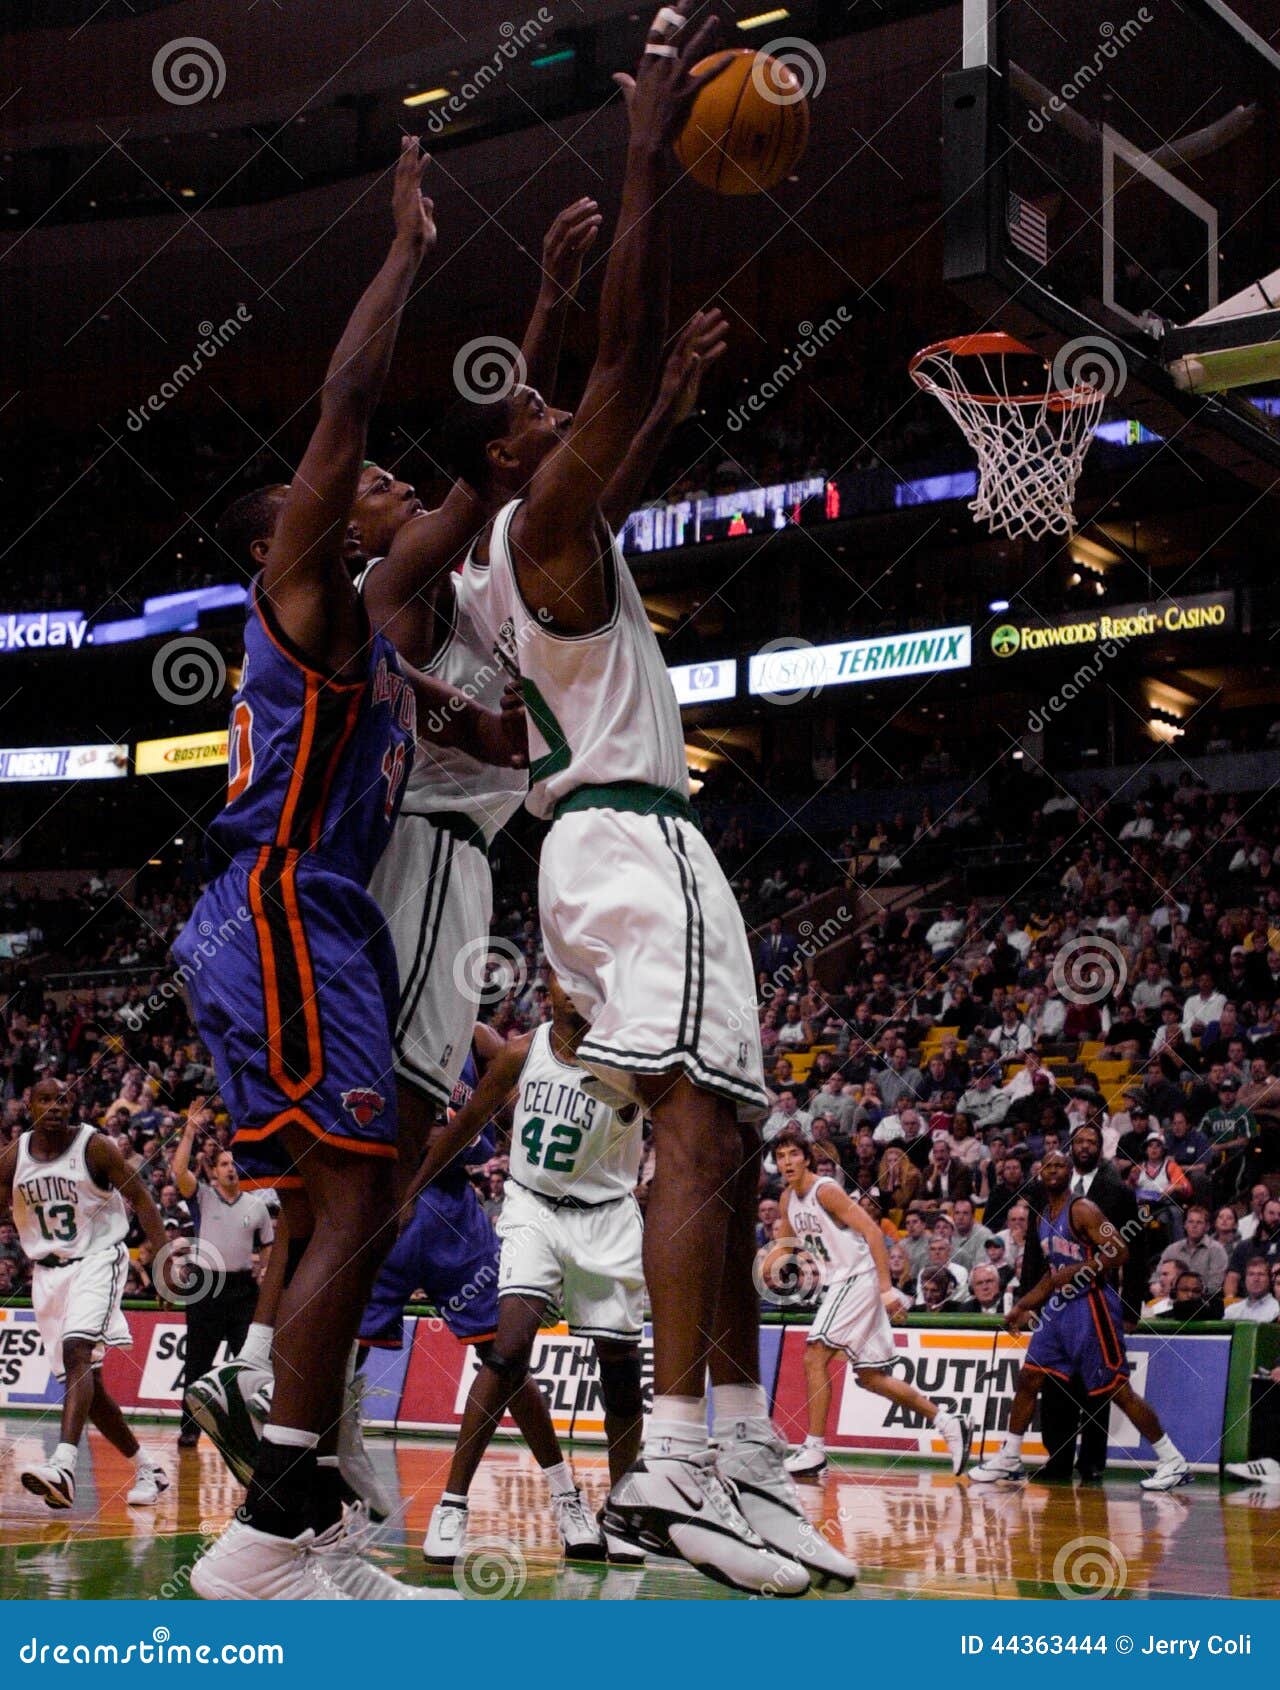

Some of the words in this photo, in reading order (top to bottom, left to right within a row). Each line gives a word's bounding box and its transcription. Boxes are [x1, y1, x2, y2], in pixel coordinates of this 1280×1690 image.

[838, 633, 965, 676] TERMINIX
[7, 754, 59, 777] NESN
[523, 1081, 597, 1131] CELTICS
[521, 1116, 583, 1173] 42
[18, 1176, 79, 1205] CELTICS
[35, 1203, 78, 1241] 13
